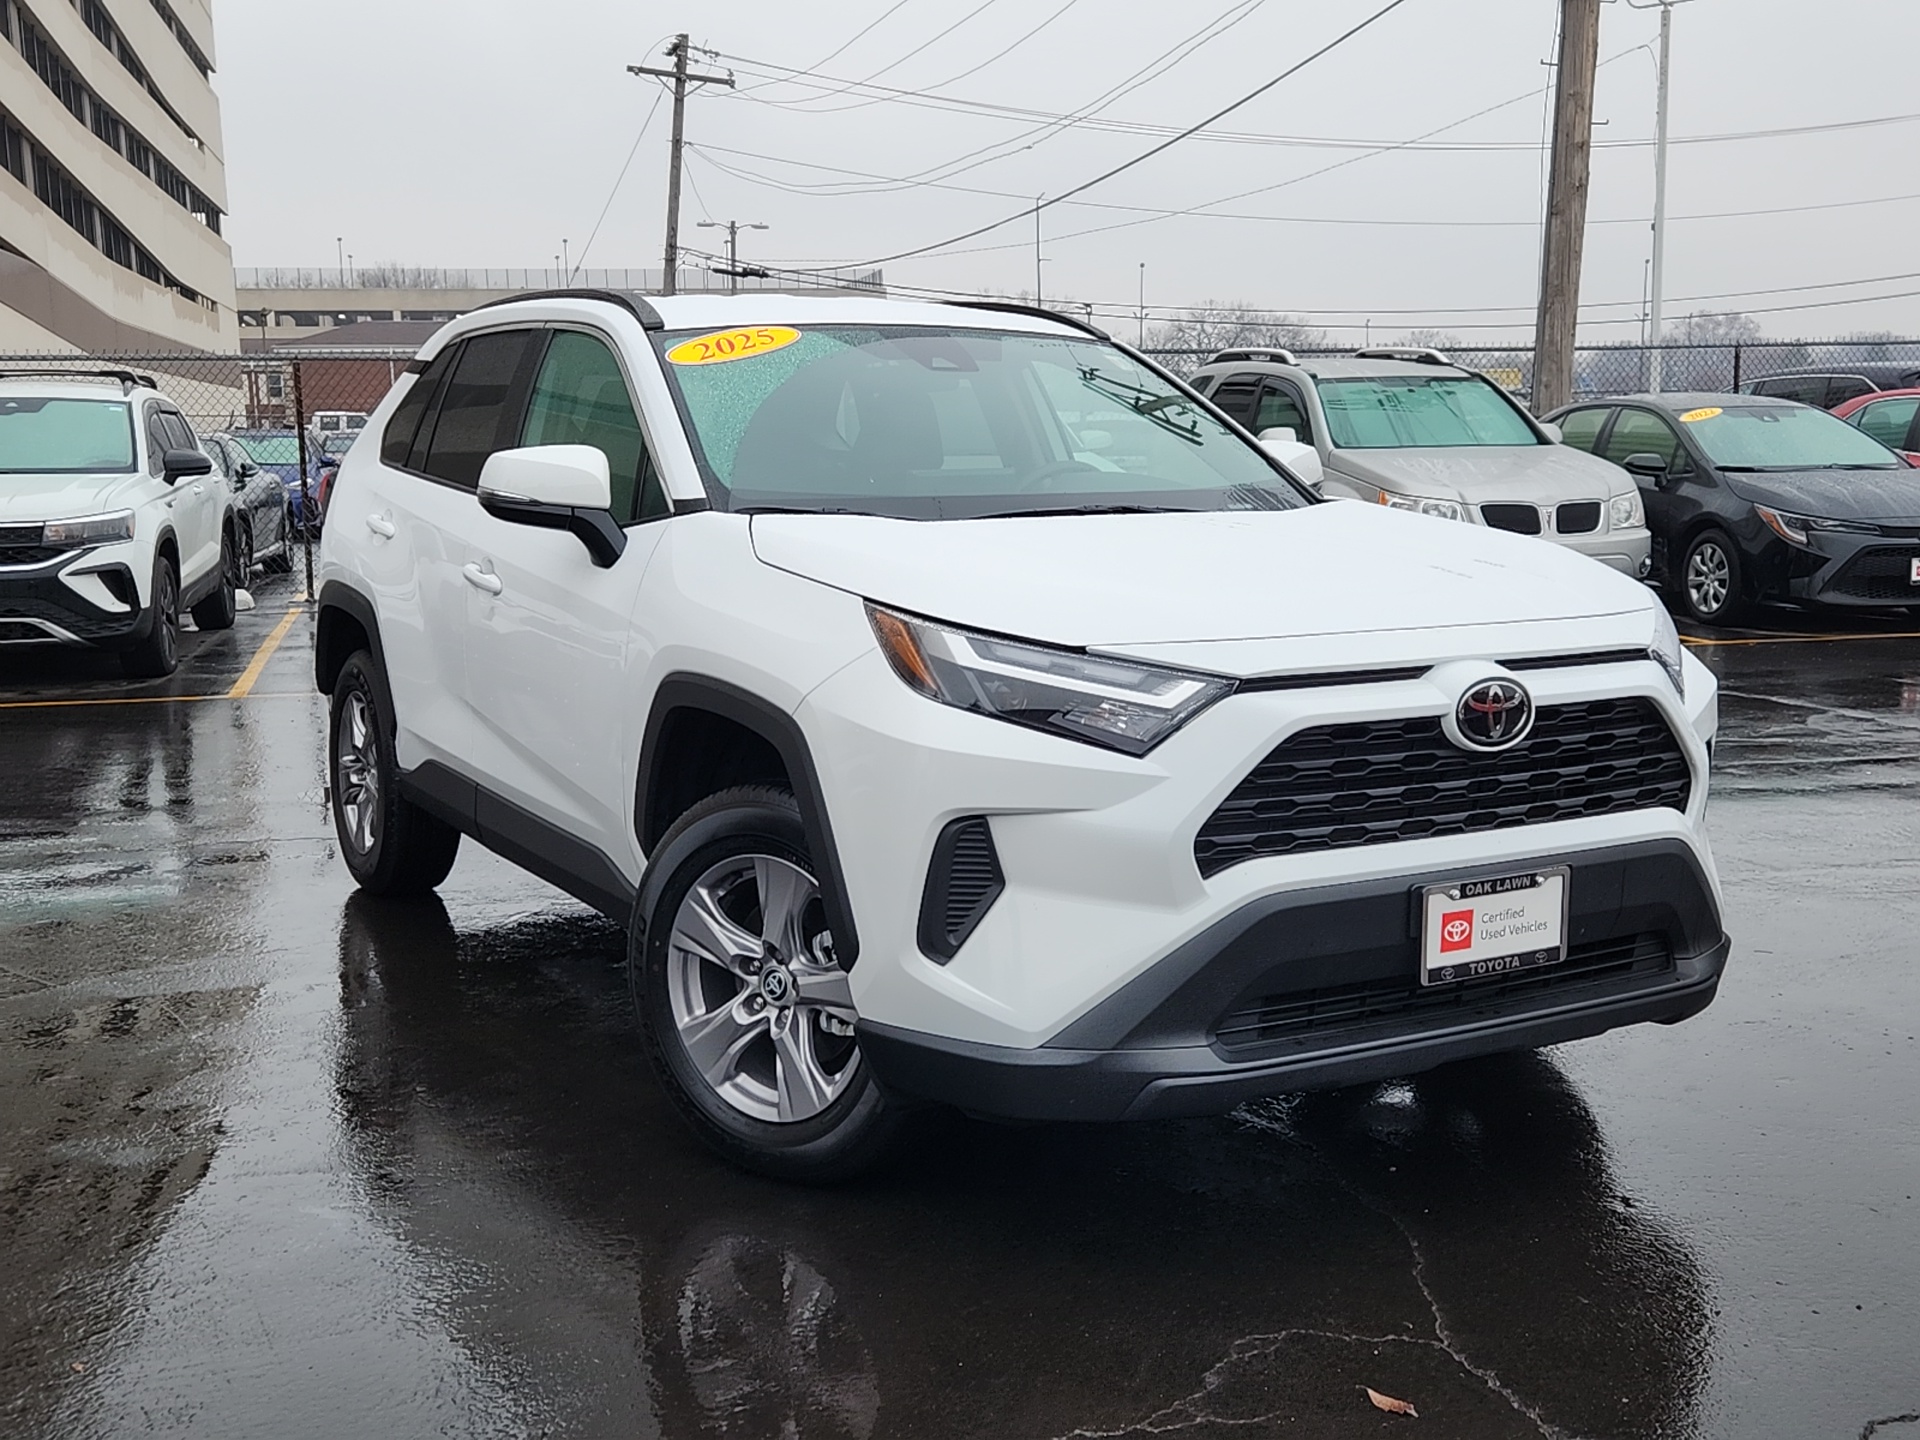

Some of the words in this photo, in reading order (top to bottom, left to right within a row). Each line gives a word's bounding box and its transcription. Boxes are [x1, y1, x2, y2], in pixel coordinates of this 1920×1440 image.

[693, 329, 775, 361] 2025
[1465, 881, 1493, 896] OAK
[1496, 876, 1531, 891] LAWN
[1481, 906, 1525, 924] Certified
[1480, 925, 1506, 940] Used
[1508, 920, 1548, 936] Vehicles
[1468, 956, 1521, 975] TOYOTA
